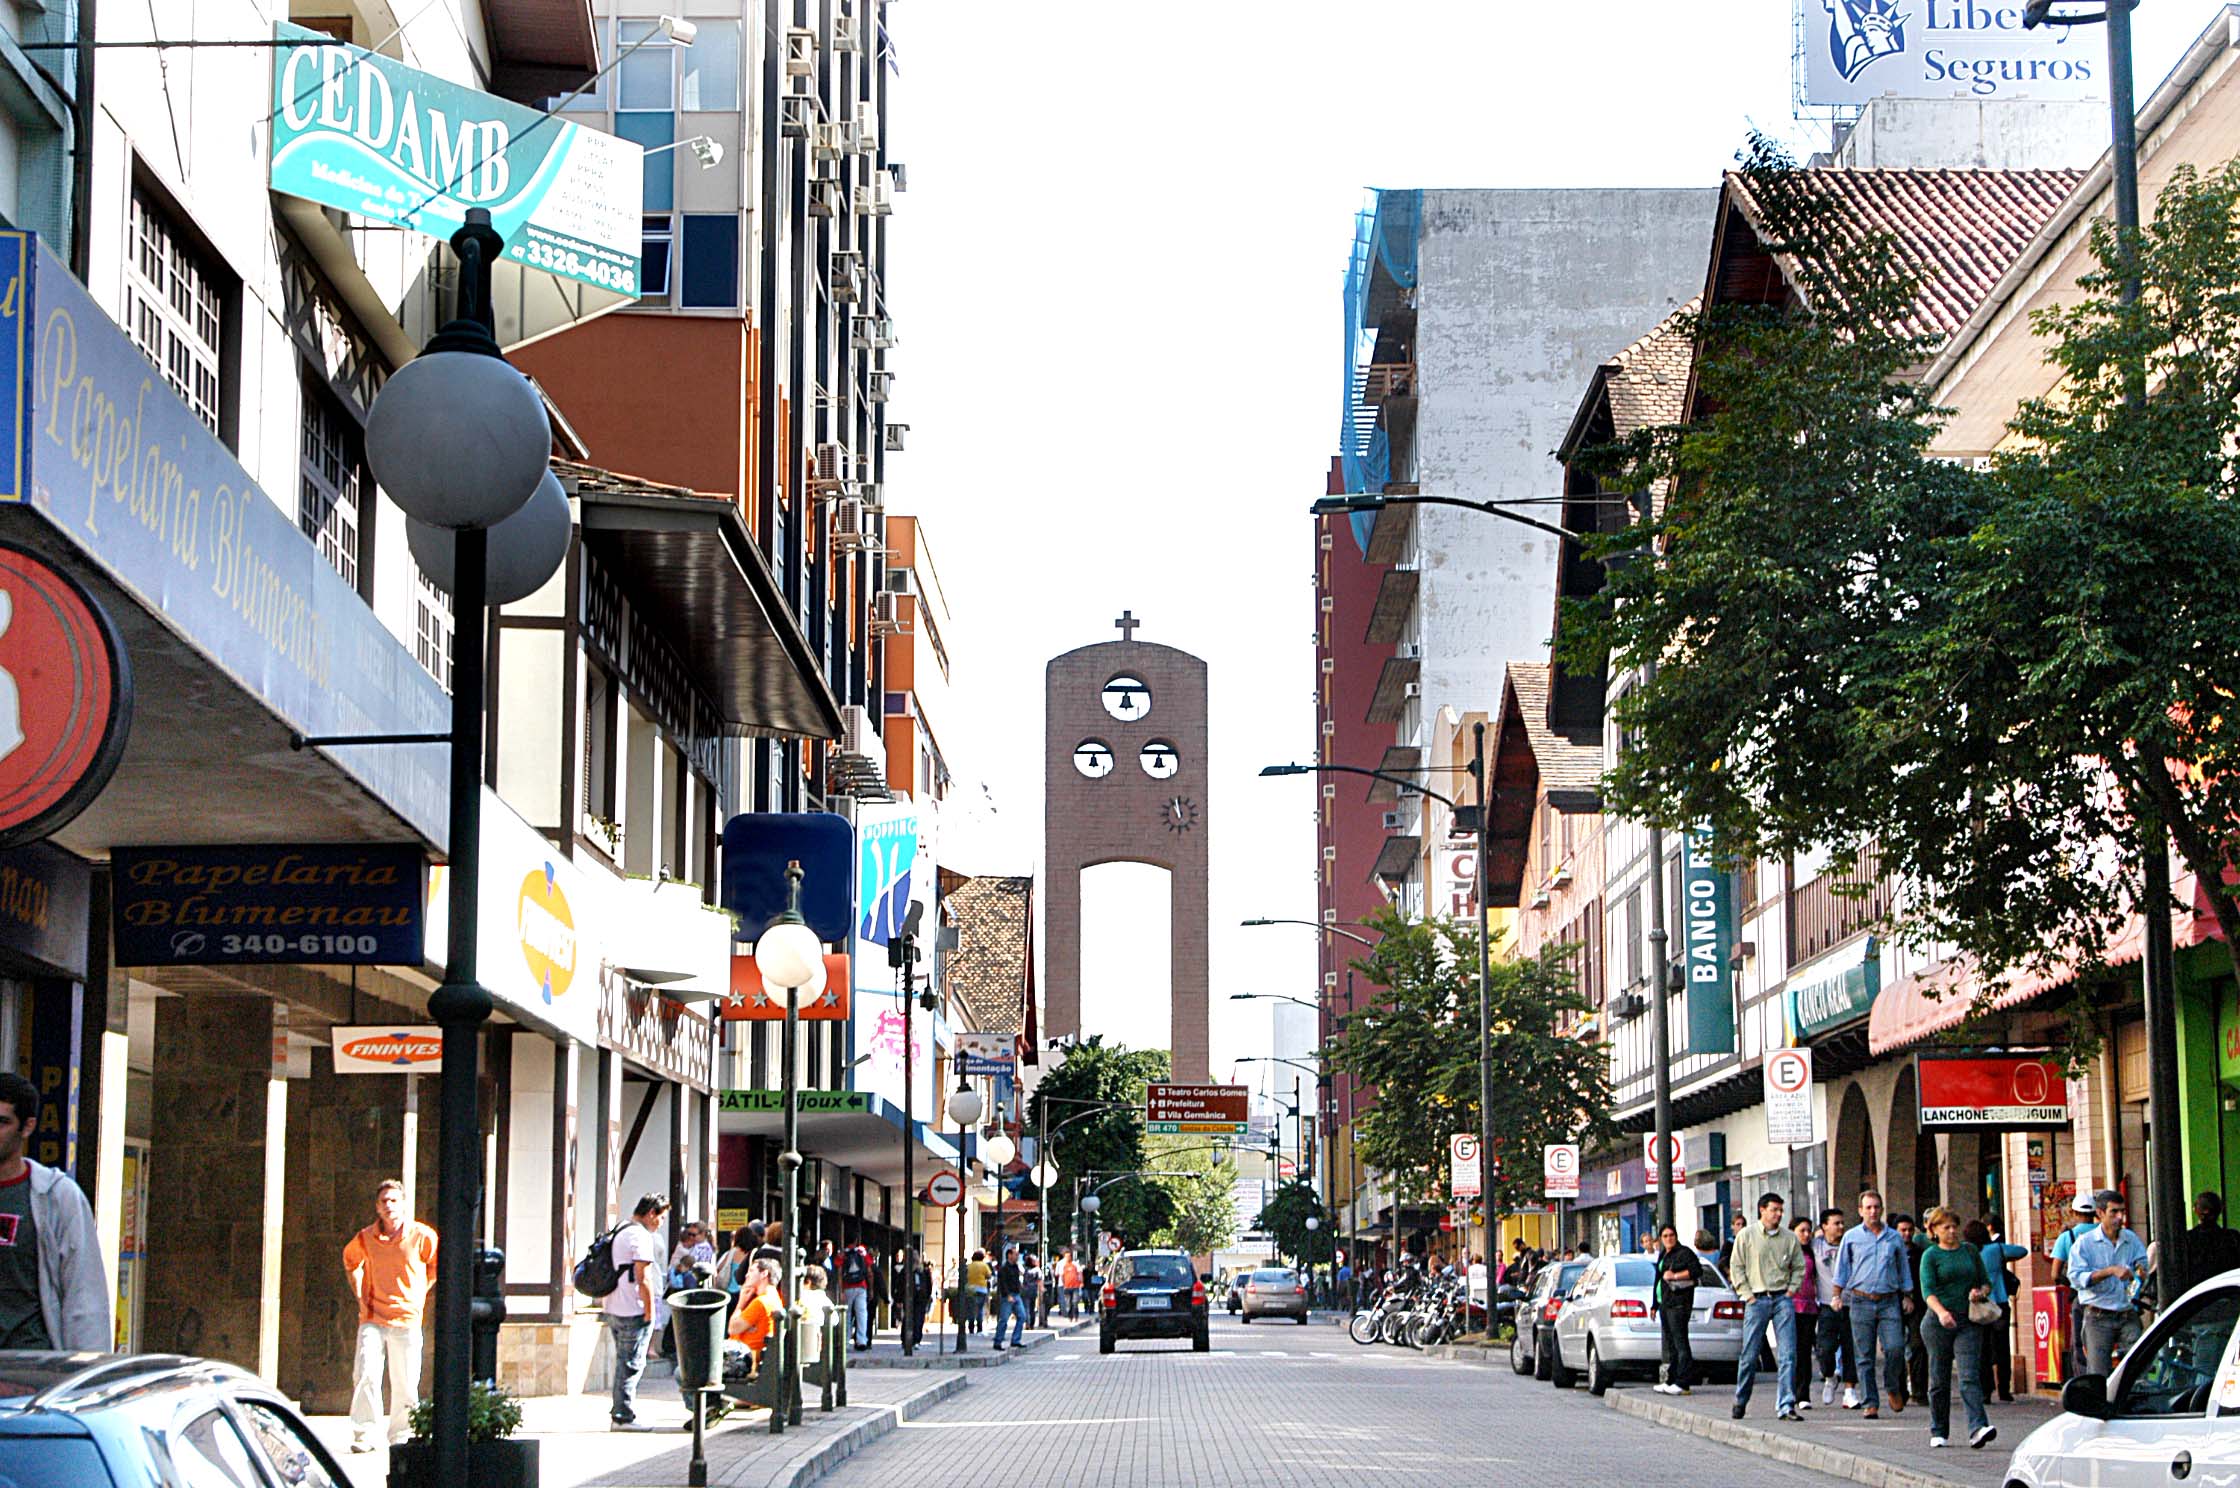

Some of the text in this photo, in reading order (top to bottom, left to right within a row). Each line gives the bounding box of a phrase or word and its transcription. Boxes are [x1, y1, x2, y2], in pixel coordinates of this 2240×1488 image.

[1924, 49, 2092, 95] Seguros
[281, 44, 511, 204] CEDAMB
[527, 239, 636, 294] 3326-4036
[41, 306, 201, 572] Papelaria
[210, 484, 334, 692] Blumenau
[863, 818, 918, 840] SHOPPING
[129, 853, 400, 895] Papelaria
[123, 896, 412, 927] Blumenau
[1689, 879, 1718, 983] BANCO
[221, 934, 378, 955] 340-6100
[1781, 1061, 1796, 1084] E
[1167, 1088, 1247, 1096] Teatro Carlos Gomes
[1167, 1100, 1205, 1108] Prefeitura
[1167, 1110, 1226, 1119] Vila Germânica
[1149, 1124, 1177, 1132] BR 470
[1461, 1141, 1470, 1155] E
[1557, 1152, 1567, 1168] E
